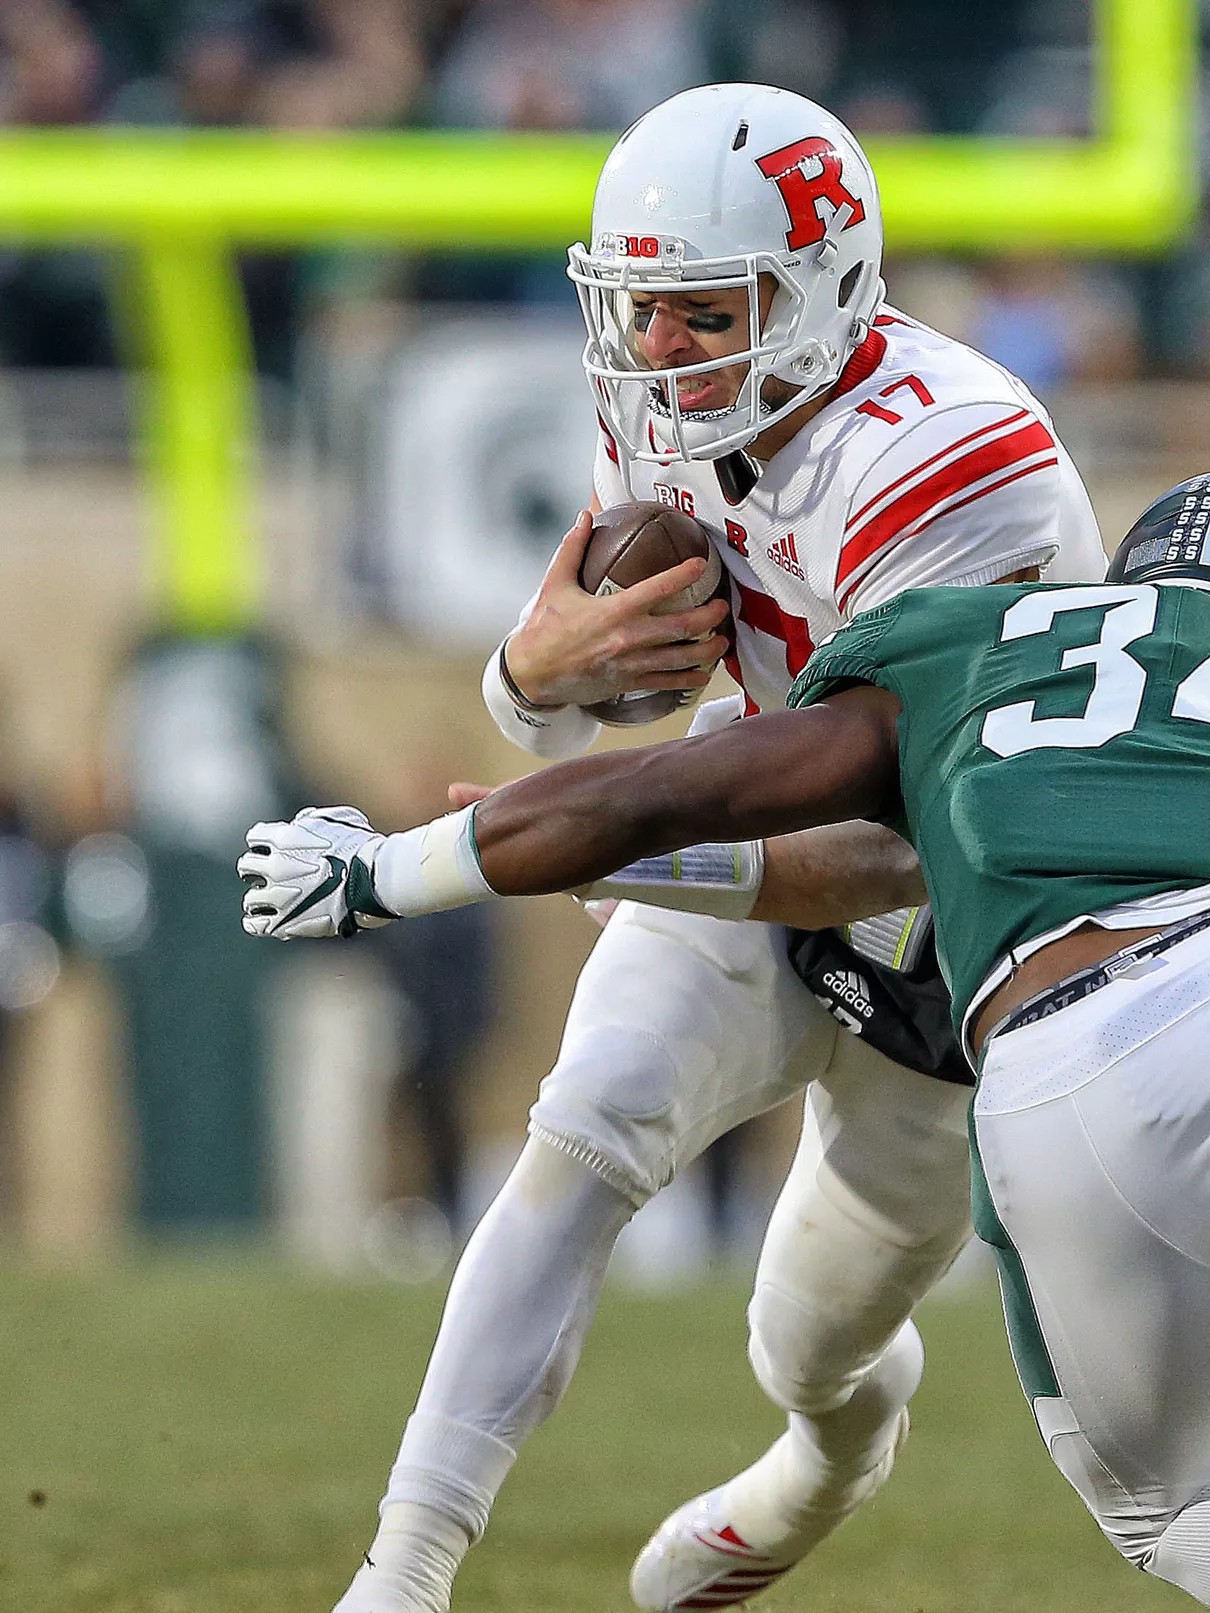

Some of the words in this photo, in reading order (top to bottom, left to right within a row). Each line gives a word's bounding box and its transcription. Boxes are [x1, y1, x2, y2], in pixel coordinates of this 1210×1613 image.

[754, 135, 866, 252] R
[855, 374, 935, 425] 17
[1177, 512, 1191, 525] S
[1195, 512, 1208, 525] S
[1184, 496, 1197, 510] S
[724, 517, 749, 558] R
[1171, 528, 1184, 542] S
[1190, 528, 1202, 542] S
[767, 547, 805, 581] adidas
[1166, 546, 1180, 560] S
[1185, 545, 1198, 560] S
[823, 973, 874, 1018] adidas
